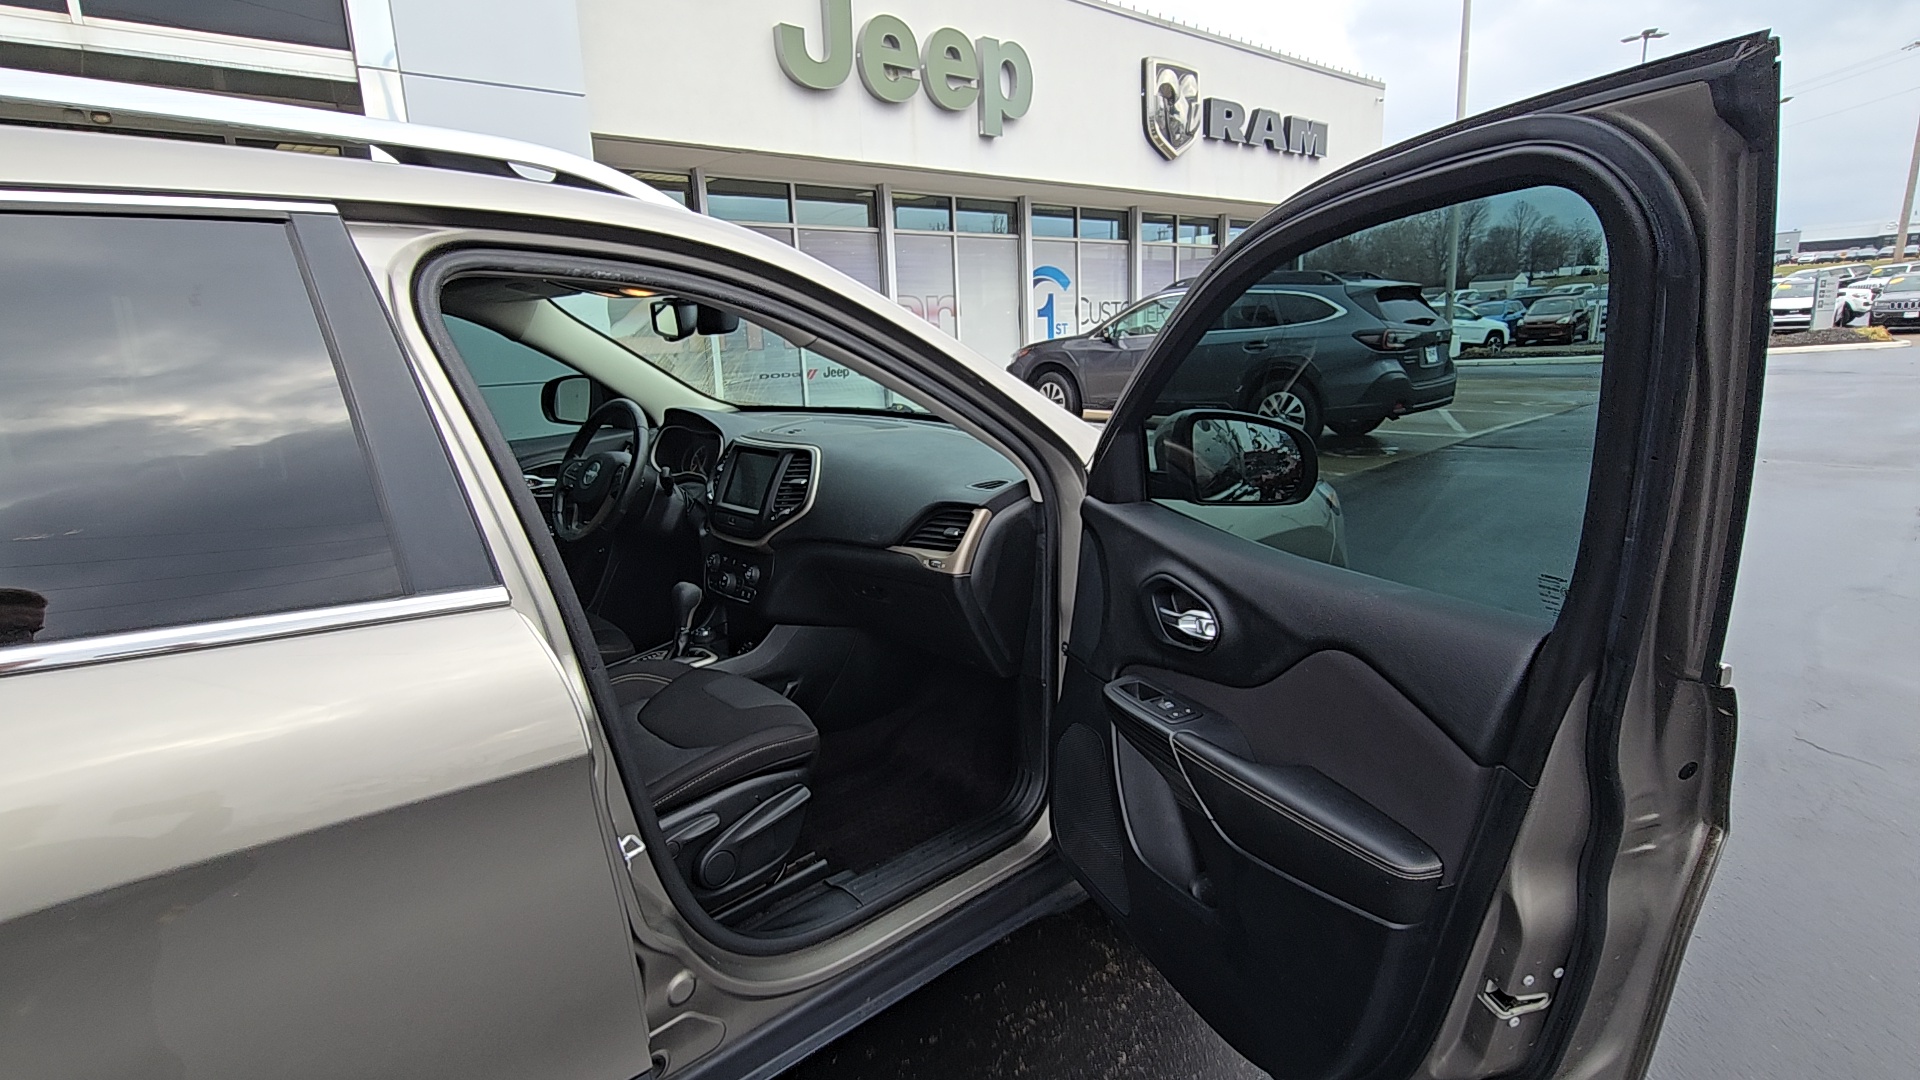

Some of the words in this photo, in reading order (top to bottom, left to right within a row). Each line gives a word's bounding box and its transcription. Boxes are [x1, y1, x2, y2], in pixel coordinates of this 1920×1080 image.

[773, 0, 1033, 138] Jeep
[1203, 97, 1328, 159] RAM
[1075, 297, 1167, 326] CUSTER
[759, 372, 803, 380] DODG
[823, 366, 850, 379] Jeep
